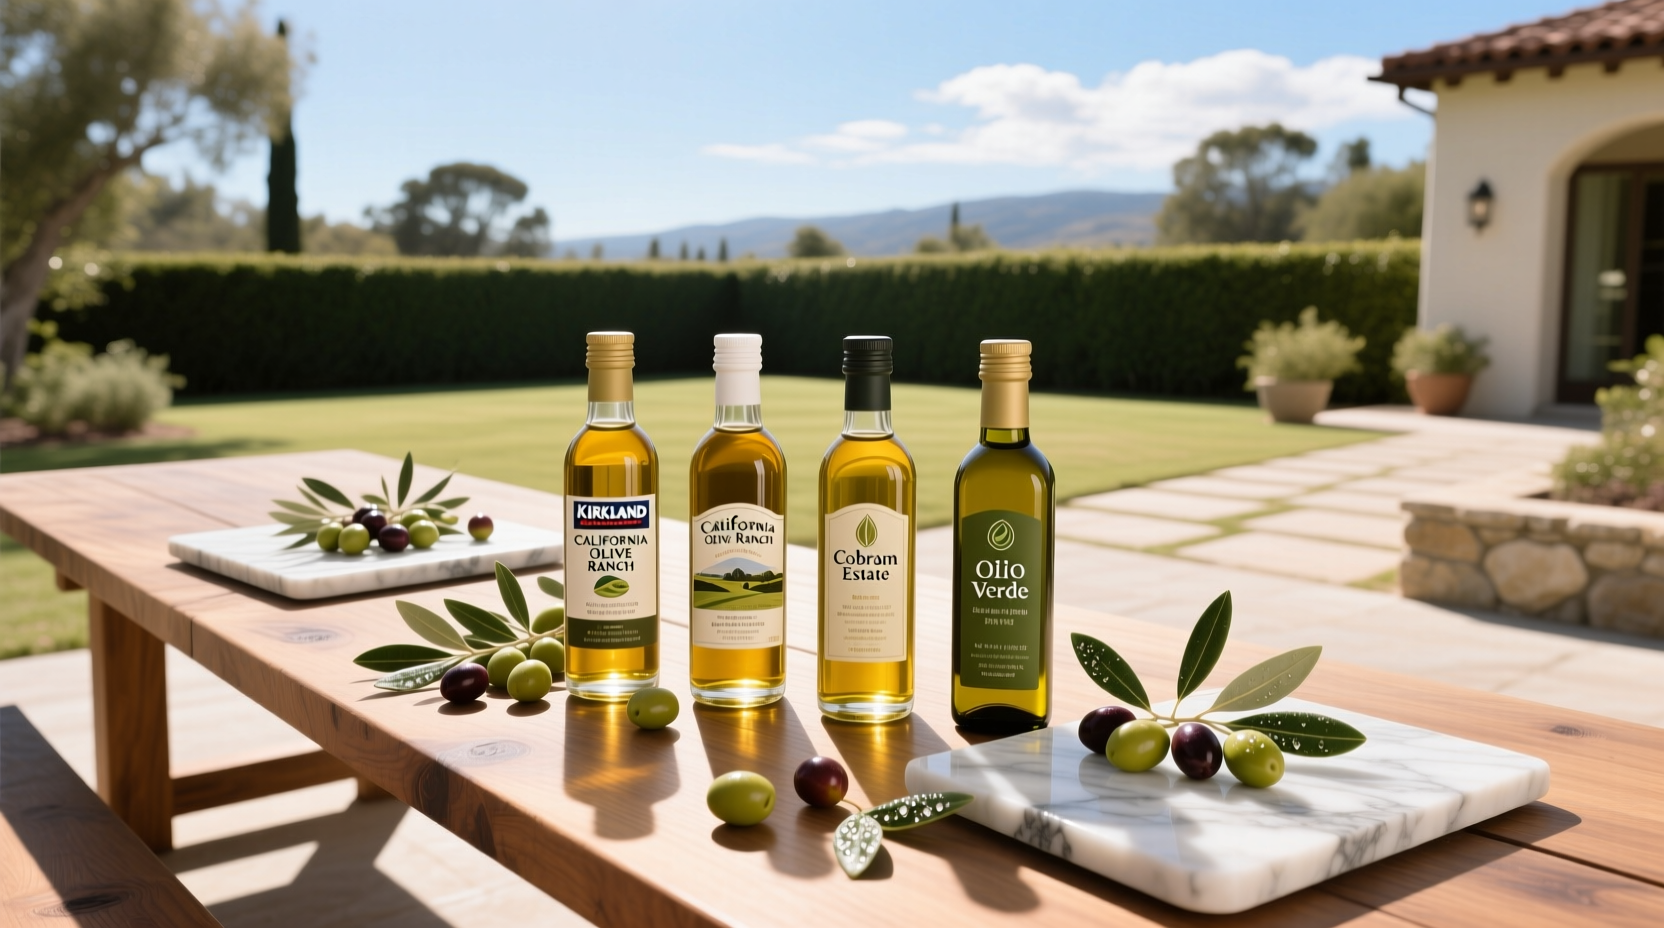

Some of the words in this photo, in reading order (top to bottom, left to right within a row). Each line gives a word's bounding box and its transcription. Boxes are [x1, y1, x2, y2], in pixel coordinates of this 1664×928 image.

[577, 504, 647, 519] KIRKLAND
[574, 534, 648, 546] CALIFORNIA
[589, 547, 632, 559] OLIVE
[833, 549, 897, 565] Cobram
[587, 560, 634, 572] RANCH
[842, 566, 890, 580] Estate
[975, 559, 1025, 579] Olio
[971, 581, 1029, 599] Verde
